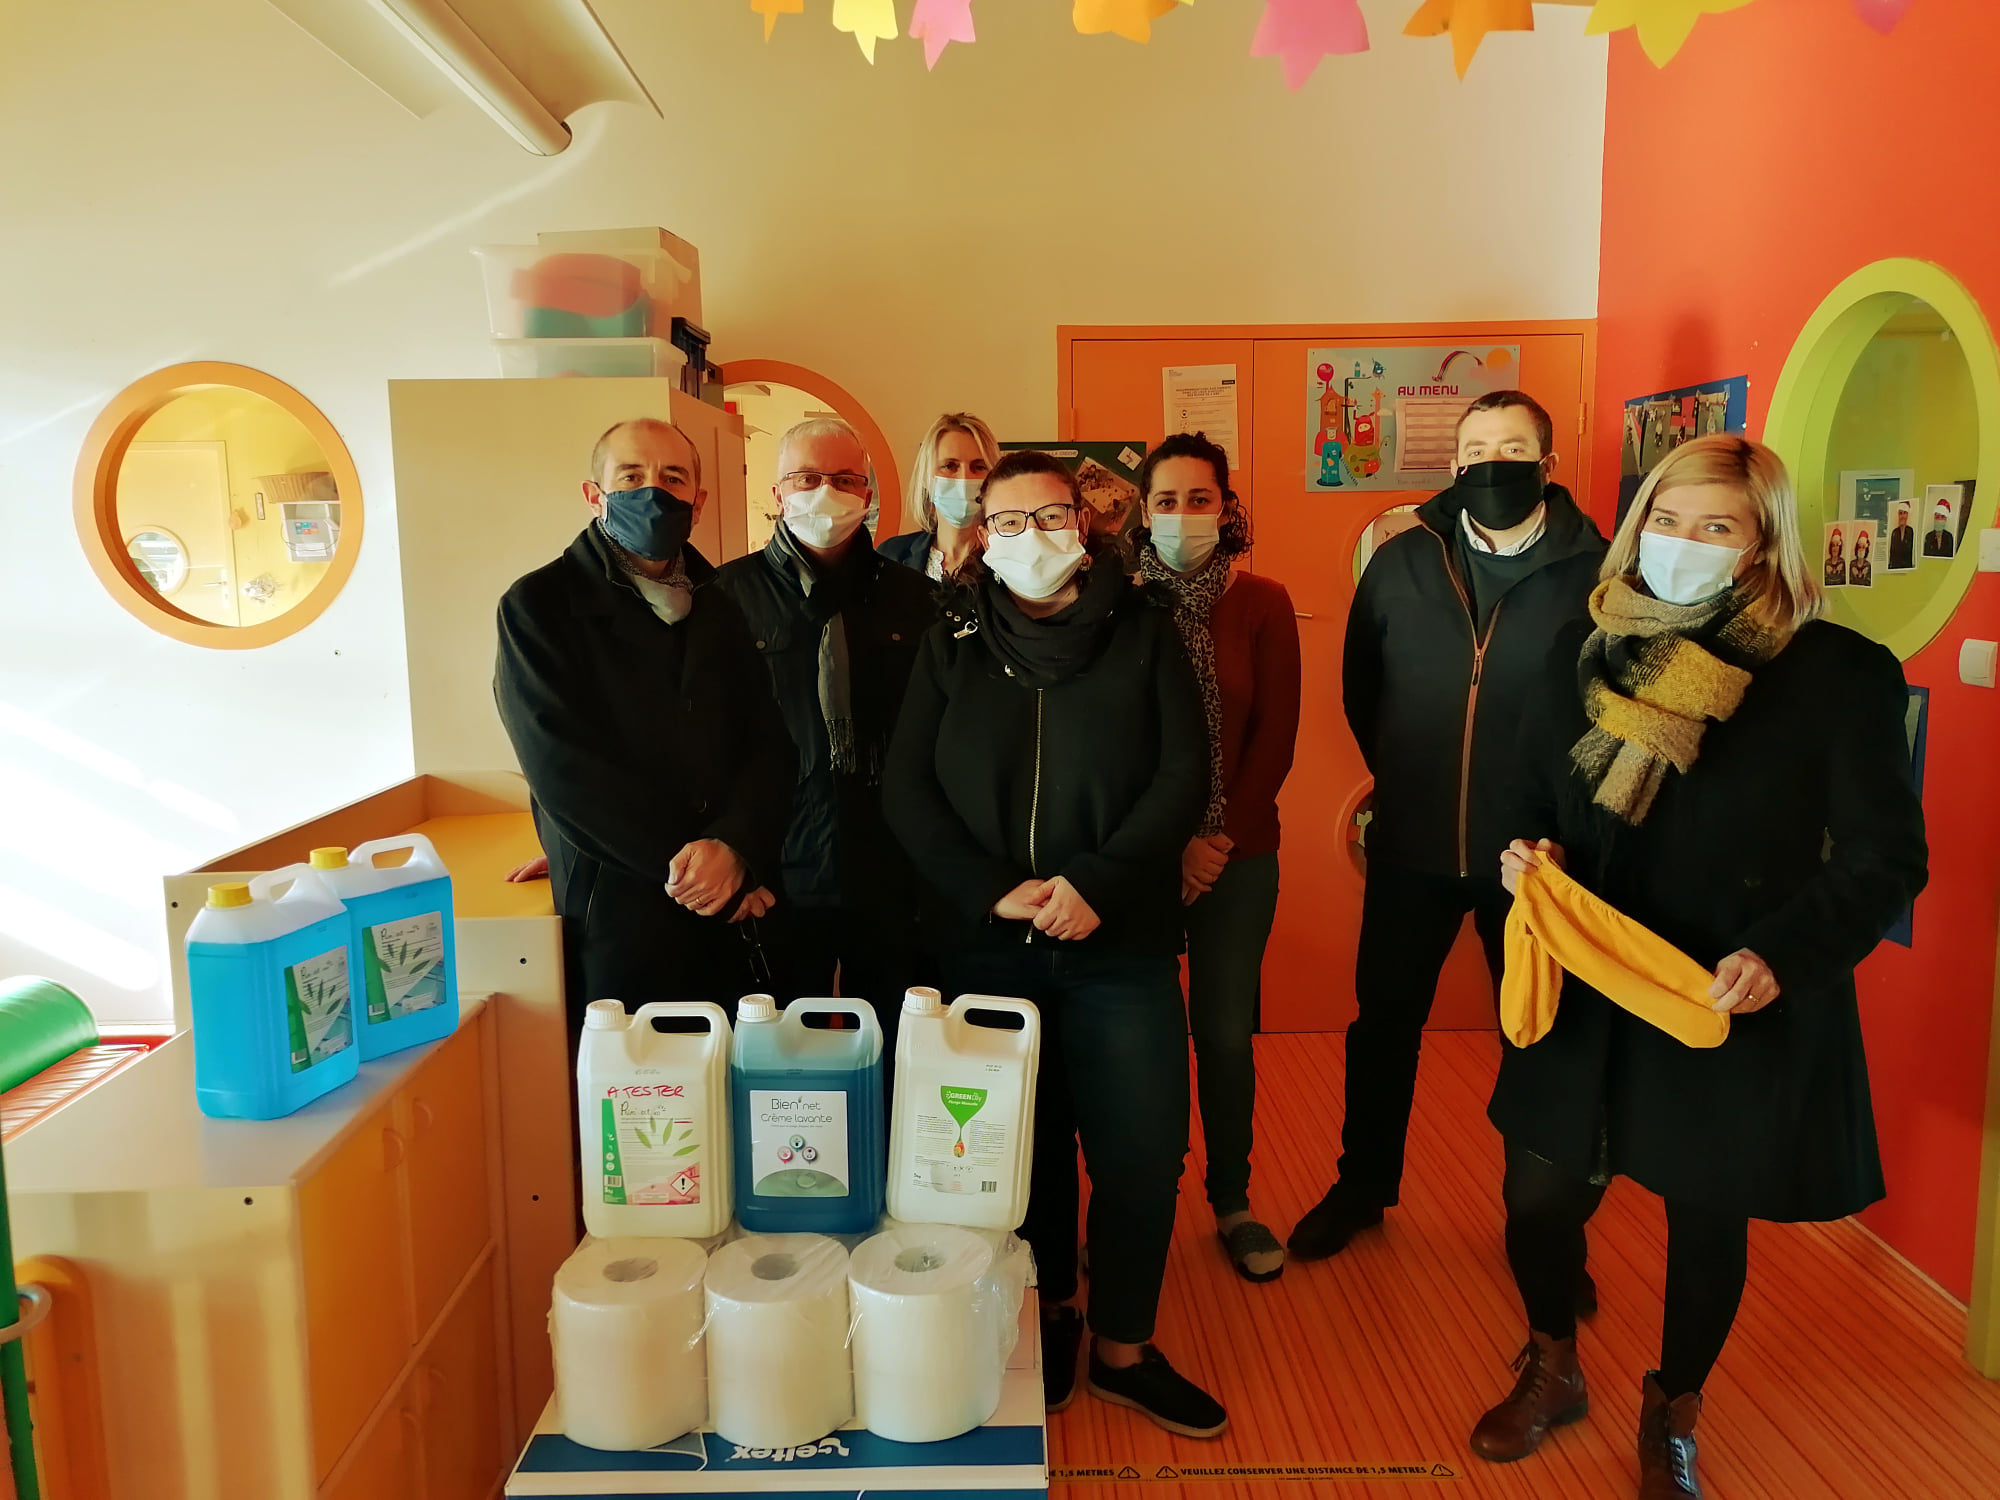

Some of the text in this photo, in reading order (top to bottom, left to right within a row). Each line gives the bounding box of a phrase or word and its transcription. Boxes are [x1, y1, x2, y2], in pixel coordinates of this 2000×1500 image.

[1397, 385, 1459, 396] AU MENU
[622, 1085, 685, 1098] TESTER
[760, 1113, 833, 1123] Crème lavante
[1059, 1469, 1074, 1477] 1,5
[1076, 1469, 1115, 1477] METRES
[1180, 1466, 1428, 1475] VEUILLEZ CONSERVER UNE DISTANCE DE 1,5 METRES
